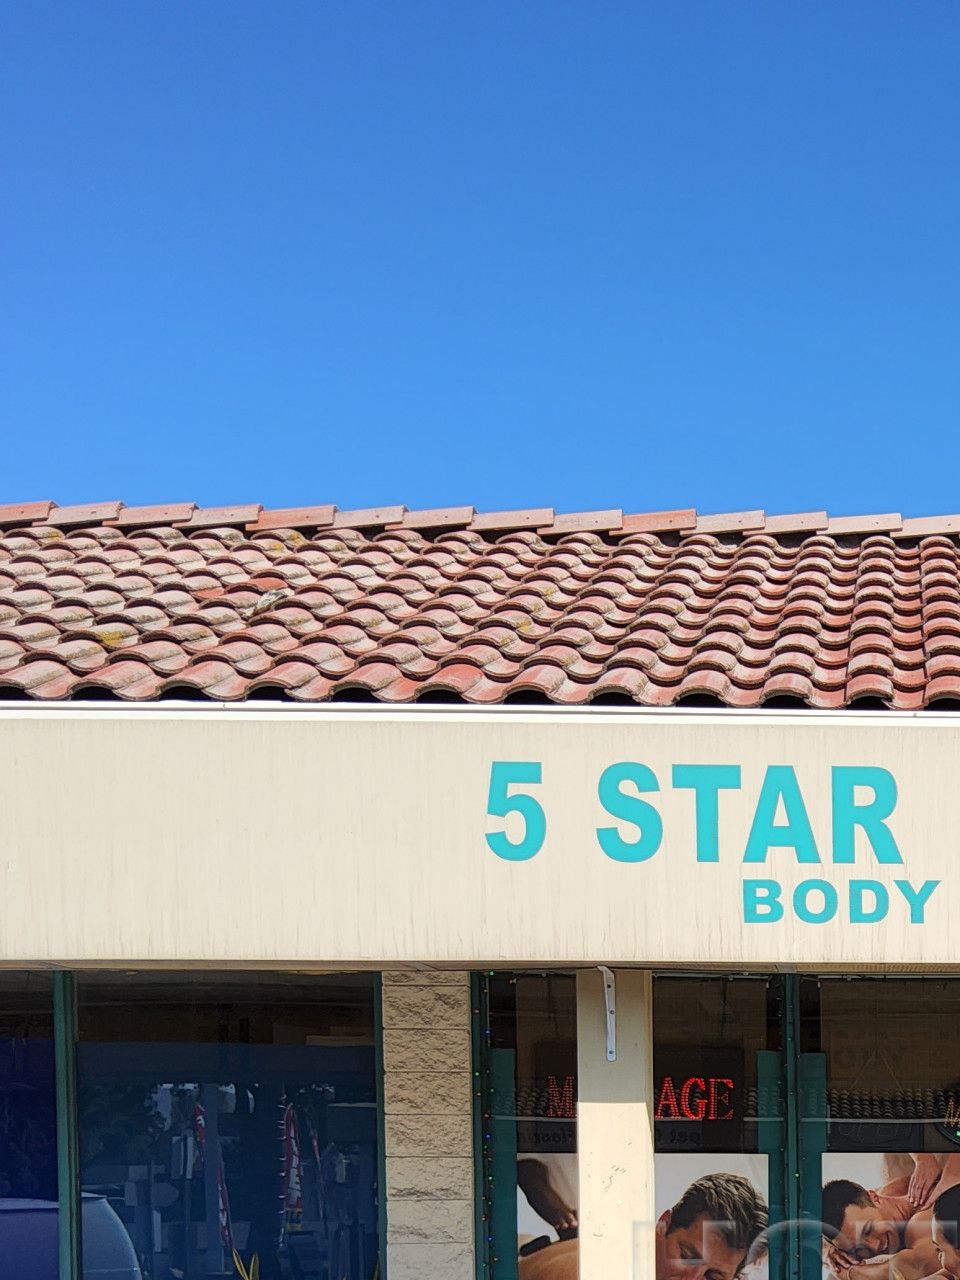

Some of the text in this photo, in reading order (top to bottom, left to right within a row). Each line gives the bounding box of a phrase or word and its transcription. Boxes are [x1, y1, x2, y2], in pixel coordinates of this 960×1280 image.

[486, 761, 547, 862] 5
[596, 761, 904, 865] STAR
[742, 879, 940, 925] BODY
